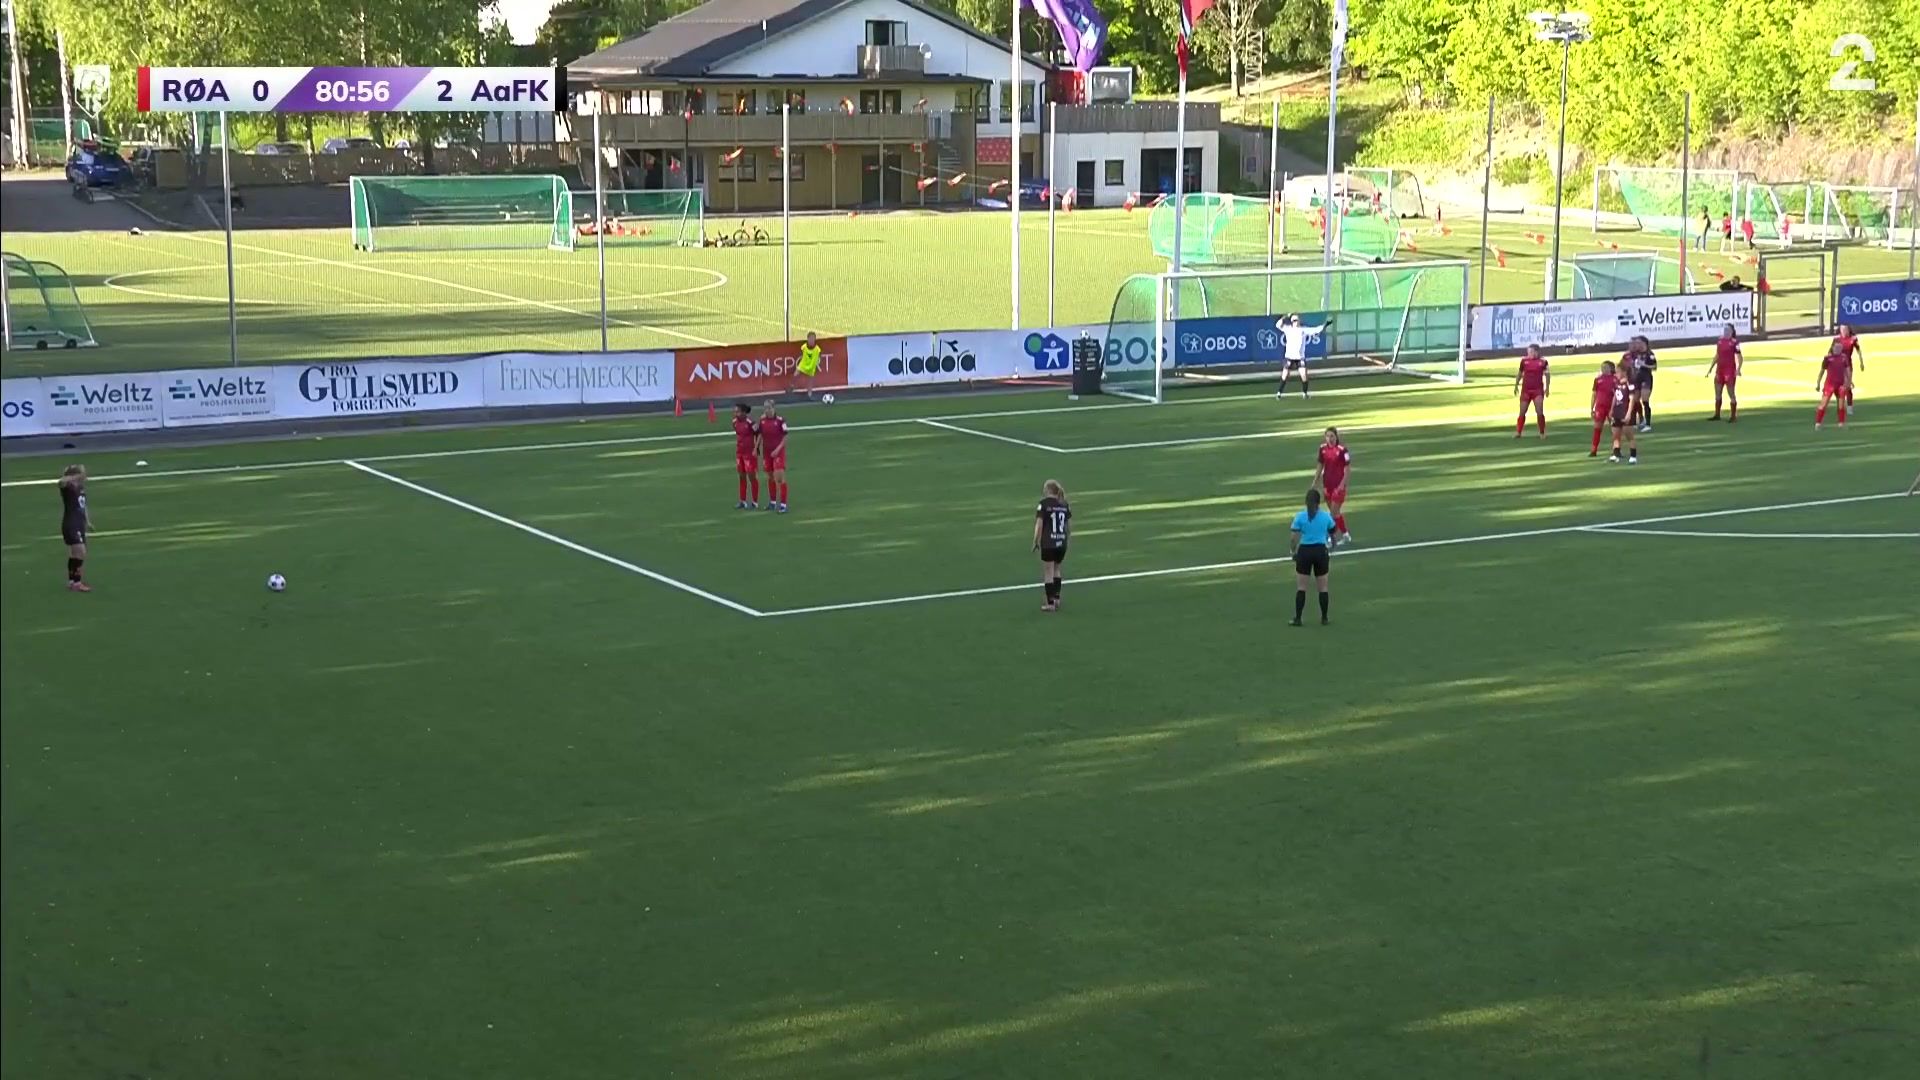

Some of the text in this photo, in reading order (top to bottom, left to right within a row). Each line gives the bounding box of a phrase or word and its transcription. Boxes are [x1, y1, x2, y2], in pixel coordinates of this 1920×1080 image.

[1638, 306, 1684, 325] Weltz
[1705, 303, 1749, 320] Weltz
[1862, 299, 1898, 313] OBOS
[1105, 336, 1168, 367] BOS
[1204, 335, 1247, 351] OBOS
[888, 339, 977, 376] diadora
[197, 376, 267, 398] Weltz
[298, 366, 459, 402] GULLSMED
[500, 359, 659, 396] FEINSCHMECKER
[81, 383, 153, 405] Weltz
[84, 404, 154, 415] PROSJEKTLEDELSE
[333, 397, 417, 413] FORRETNING
